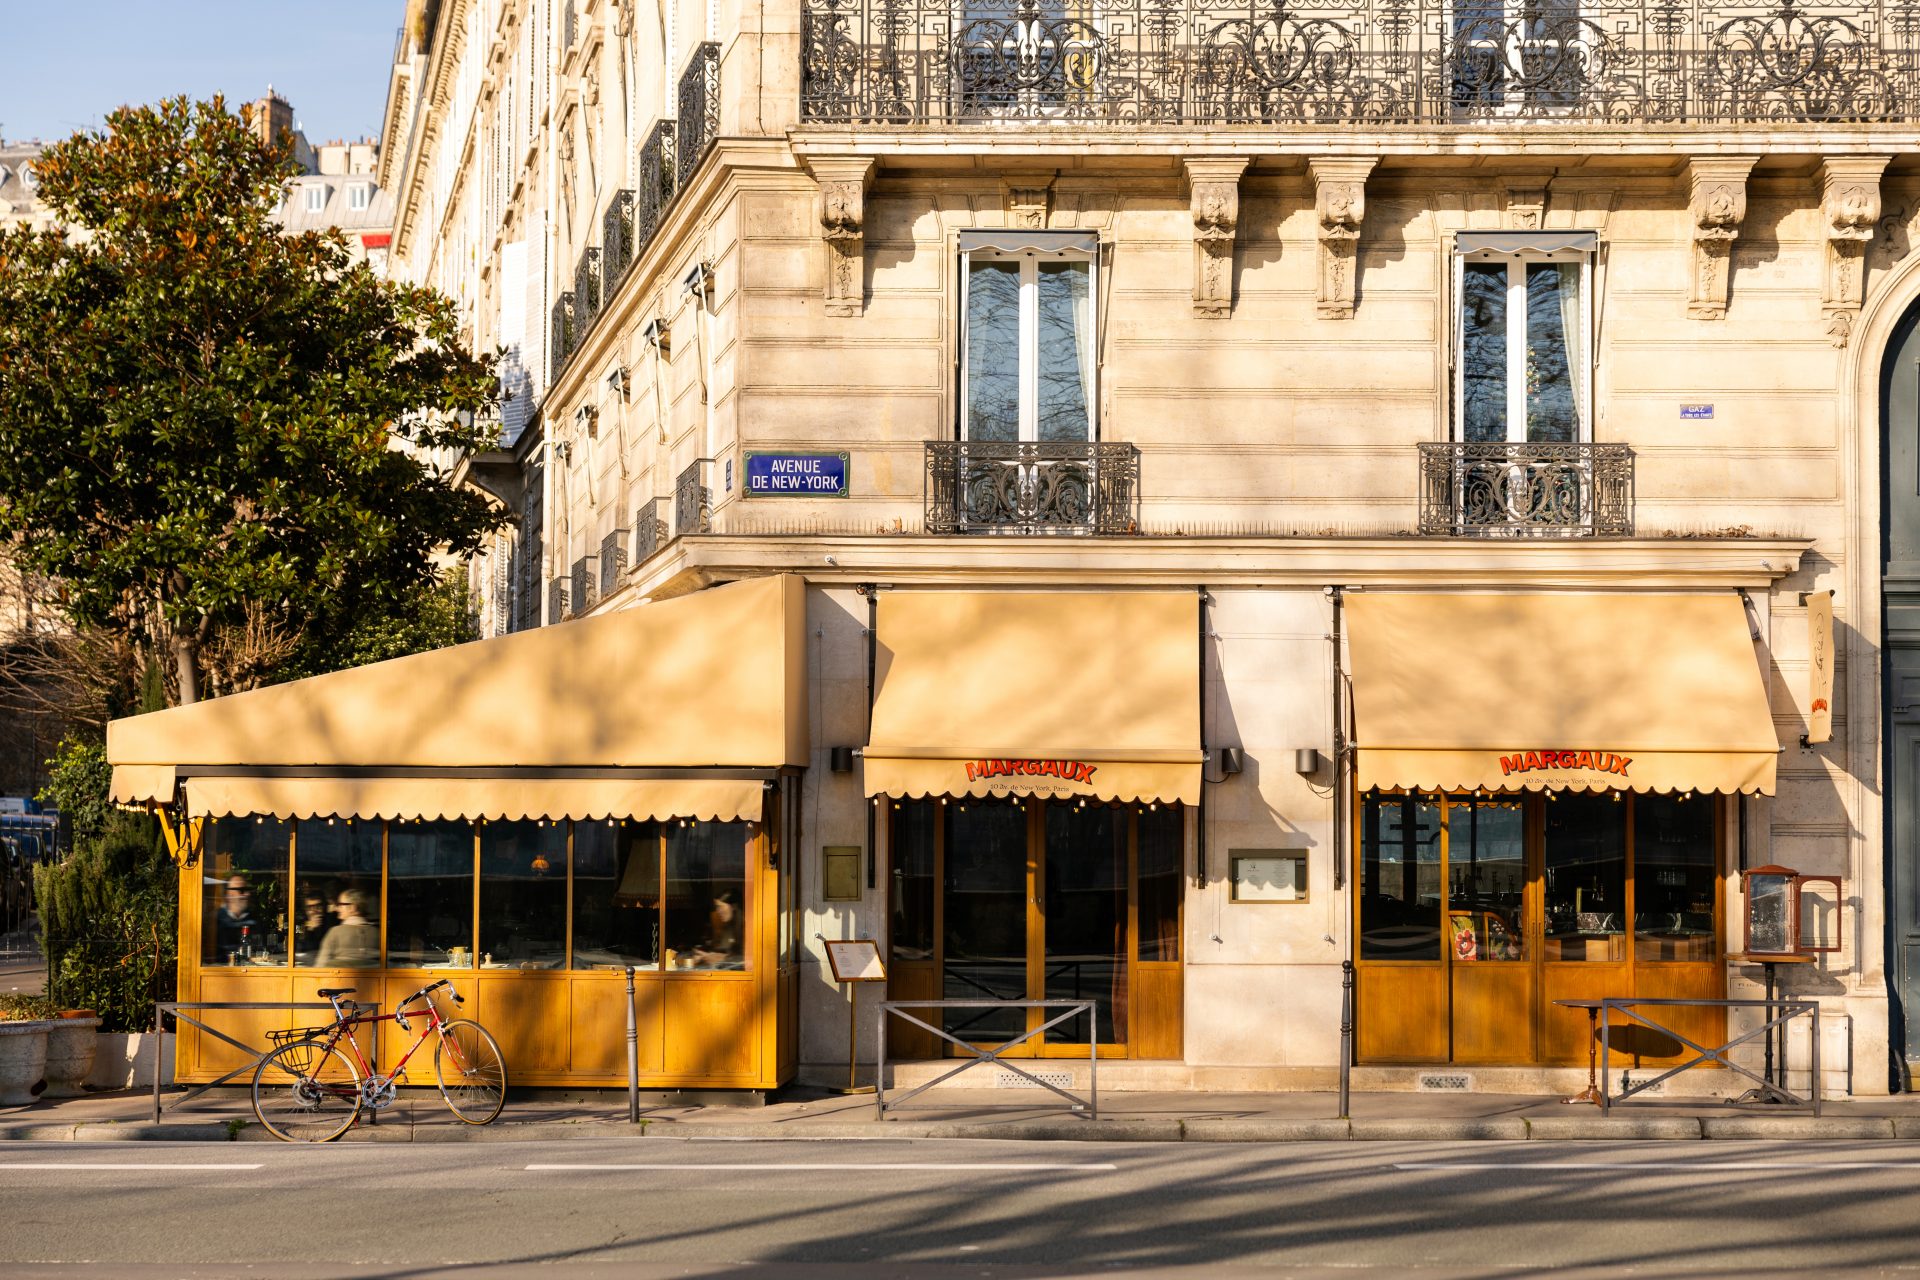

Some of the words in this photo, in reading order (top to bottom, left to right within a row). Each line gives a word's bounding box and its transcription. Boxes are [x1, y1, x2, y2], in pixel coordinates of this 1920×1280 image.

[771, 460, 821, 473] AVENUE
[752, 475, 769, 489] DE
[772, 475, 839, 490] NEW-YORK
[965, 758, 1098, 786] MARGAUX
[1499, 750, 1633, 777] MARGAUX
